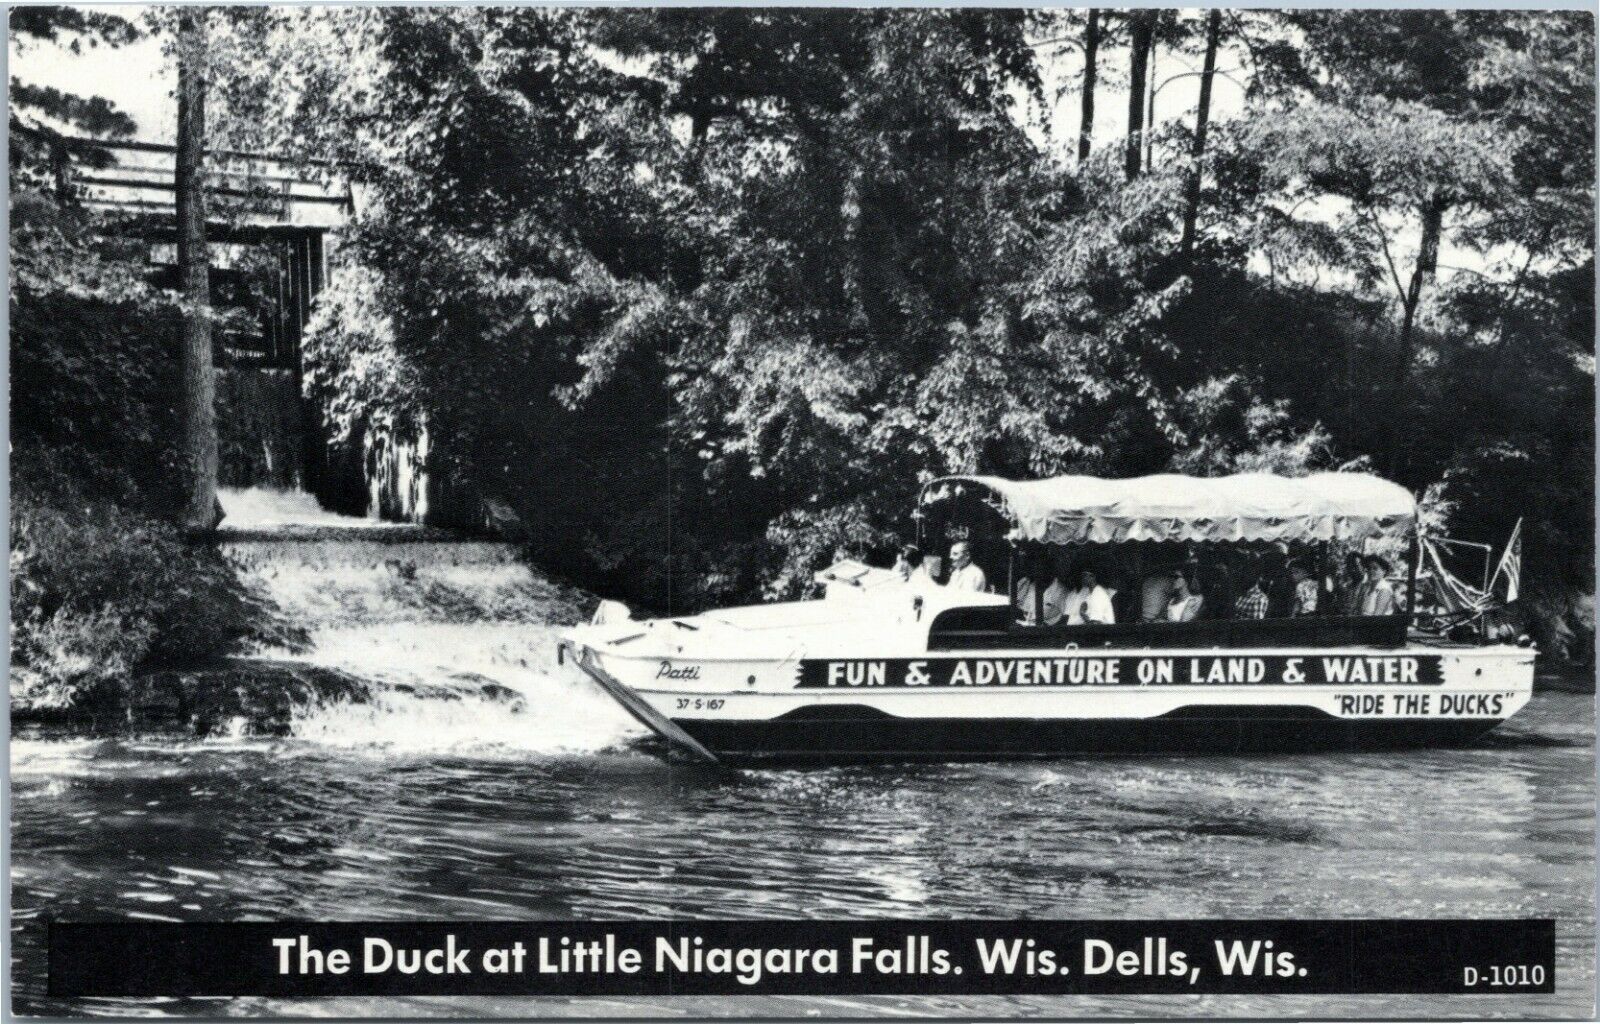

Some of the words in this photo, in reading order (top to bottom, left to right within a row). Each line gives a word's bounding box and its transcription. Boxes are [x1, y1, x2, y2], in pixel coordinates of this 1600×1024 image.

[656, 660, 700, 680] Patti
[827, 661, 887, 686] FUN
[904, 660, 931, 686] &
[949, 660, 1120, 685] ADVENTURE
[1136, 660, 1174, 685] ON
[1190, 659, 1266, 684] LAND
[1281, 659, 1306, 684] &
[1322, 658, 1419, 684] WATER
[1393, 694, 1430, 716] THE
